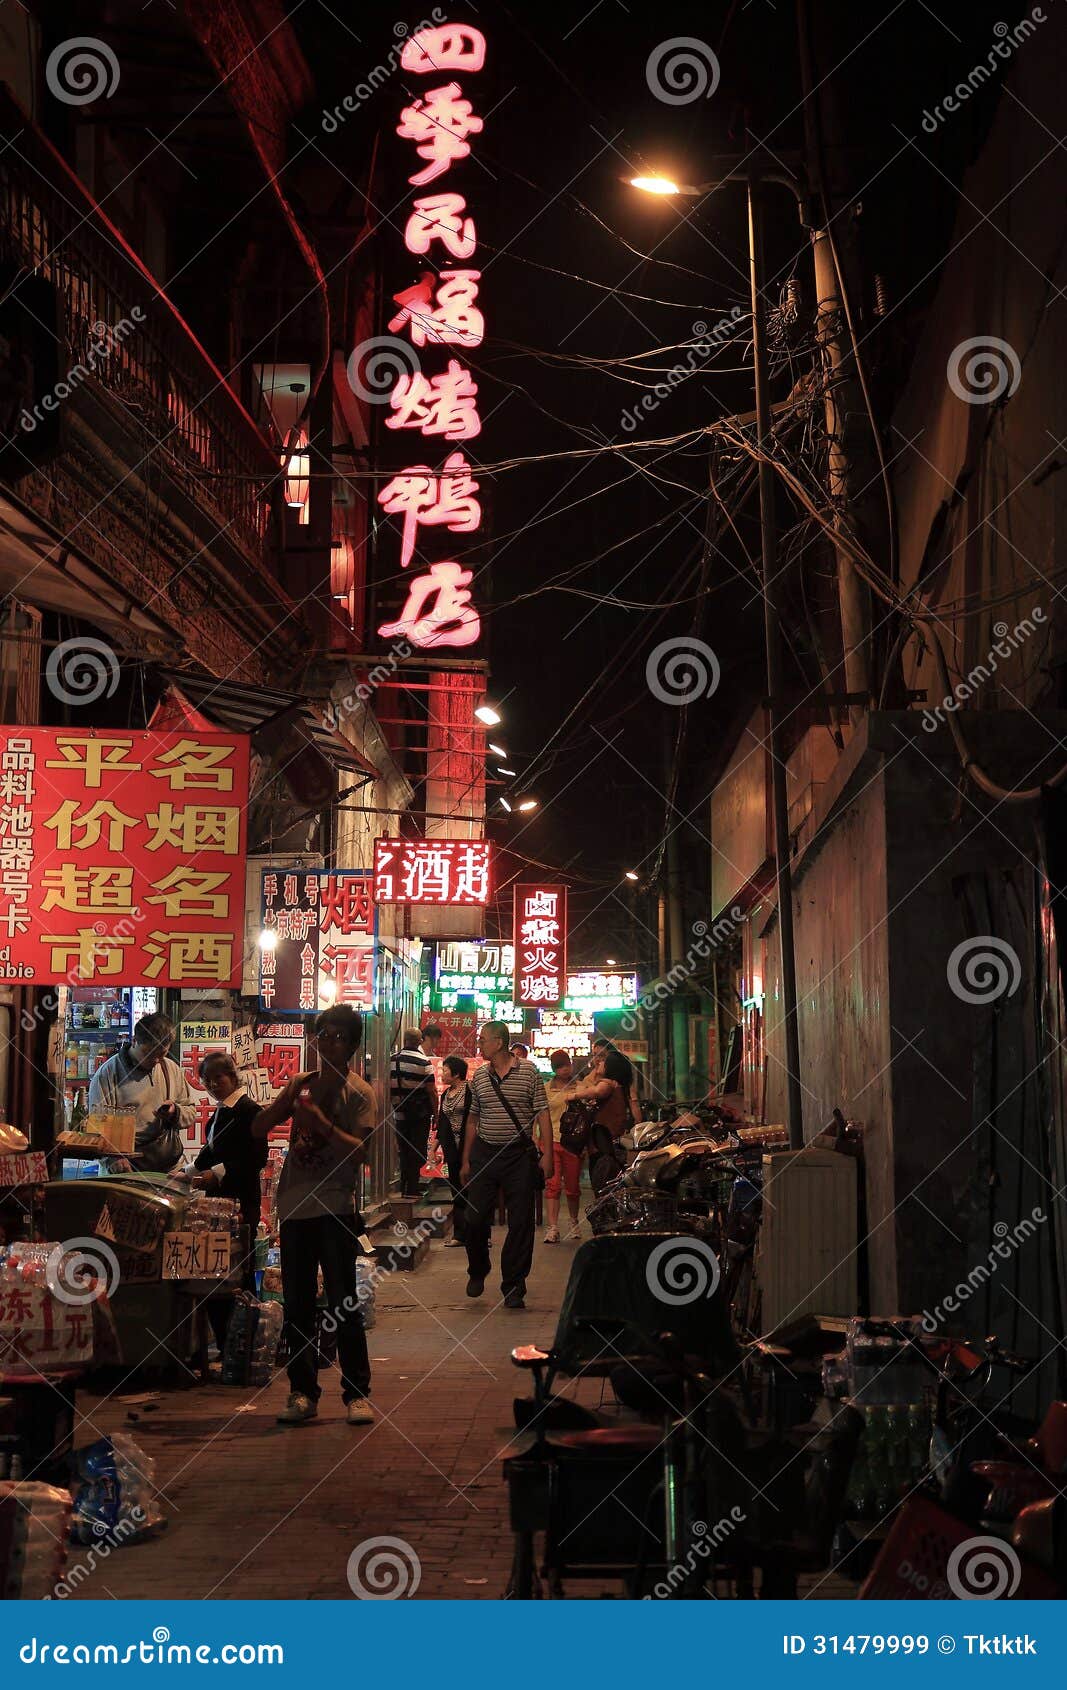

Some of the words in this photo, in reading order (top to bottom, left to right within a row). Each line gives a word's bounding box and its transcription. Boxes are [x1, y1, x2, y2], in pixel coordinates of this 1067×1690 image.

[378, 23, 486, 648] 四季民福烤鸭店
[40, 736, 142, 980] 平价超市
[143, 739, 240, 983] 名烟名酒
[263, 873, 319, 906] 手机号
[320, 873, 375, 1004] 烟酒
[183, 1025, 230, 1038] 物美价廉
[426, 1016, 473, 1028] 冷气开放
[167, 1235, 229, 1275] 冻水1元
